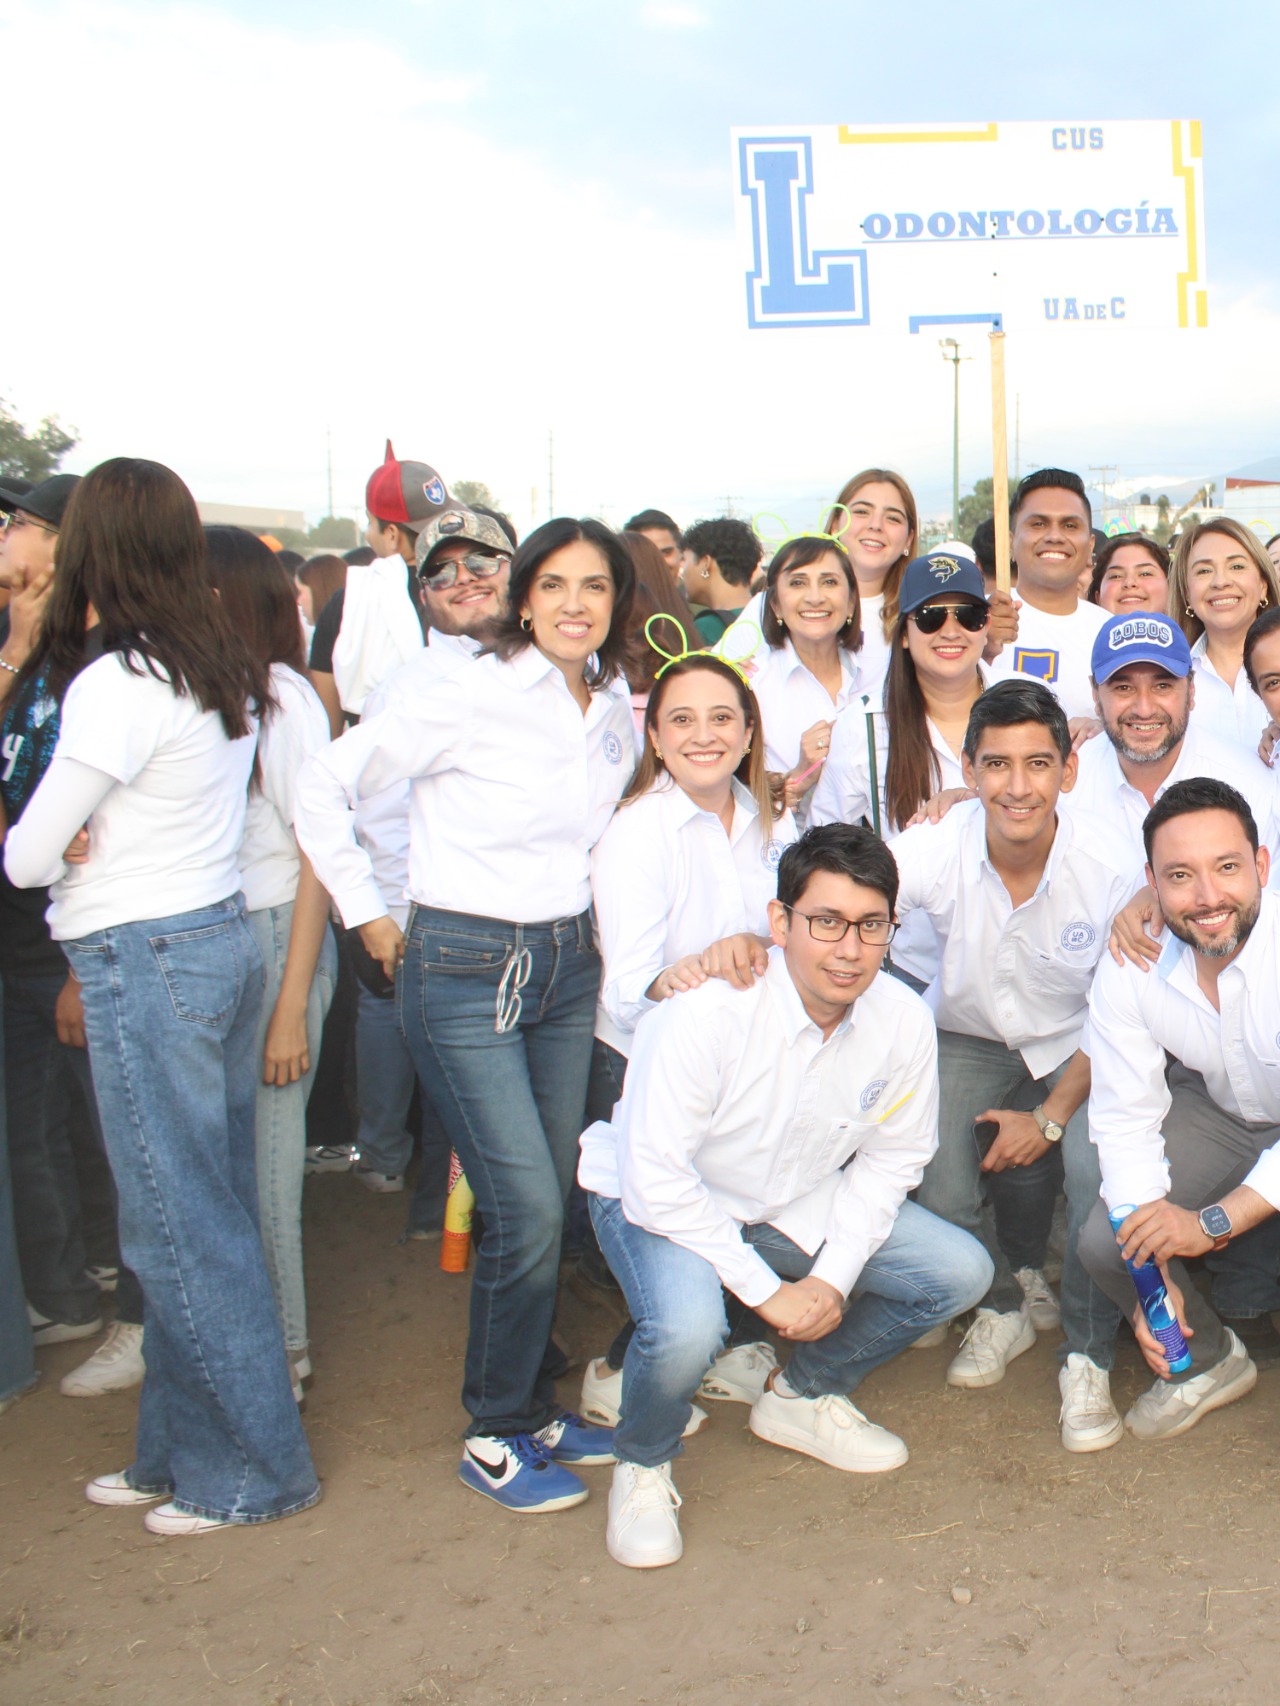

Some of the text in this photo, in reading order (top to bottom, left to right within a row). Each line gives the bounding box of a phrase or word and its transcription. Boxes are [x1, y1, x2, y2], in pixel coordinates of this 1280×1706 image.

[1052, 127, 1105, 150] CUS
[738, 135, 870, 329] L
[862, 200, 1179, 240] ODONTOLOGÍA
[1111, 620, 1172, 647] LOBOS
